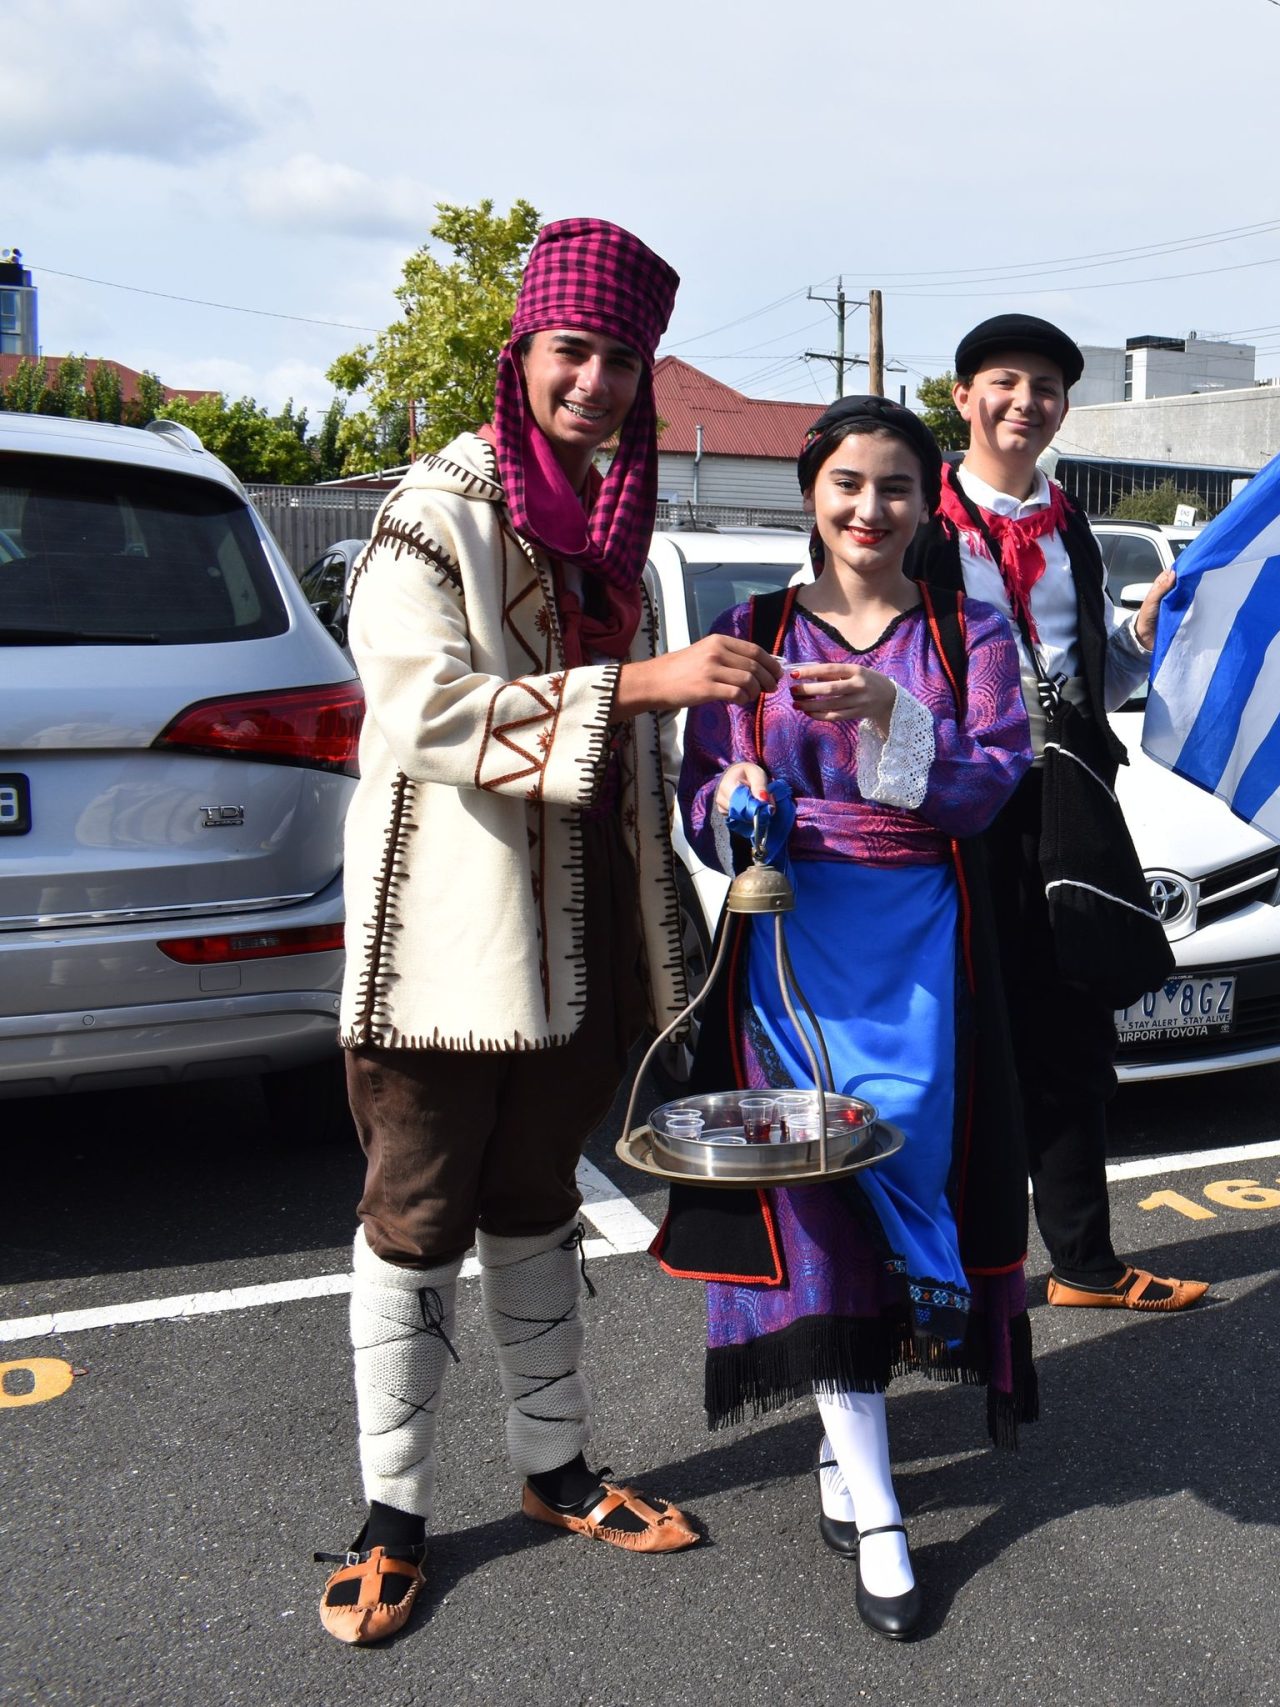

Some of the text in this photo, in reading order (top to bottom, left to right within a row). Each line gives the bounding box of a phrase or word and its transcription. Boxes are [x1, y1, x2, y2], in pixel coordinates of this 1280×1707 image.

[200, 805, 244, 820] TDI
[1180, 981, 1233, 1016] 8GZ
[1128, 1020, 1150, 1030] STAY
[1151, 1018, 1178, 1028] ALERT
[1183, 1016, 1206, 1025] STAY
[1119, 1025, 1209, 1043] AIRPORT TOYOTA
